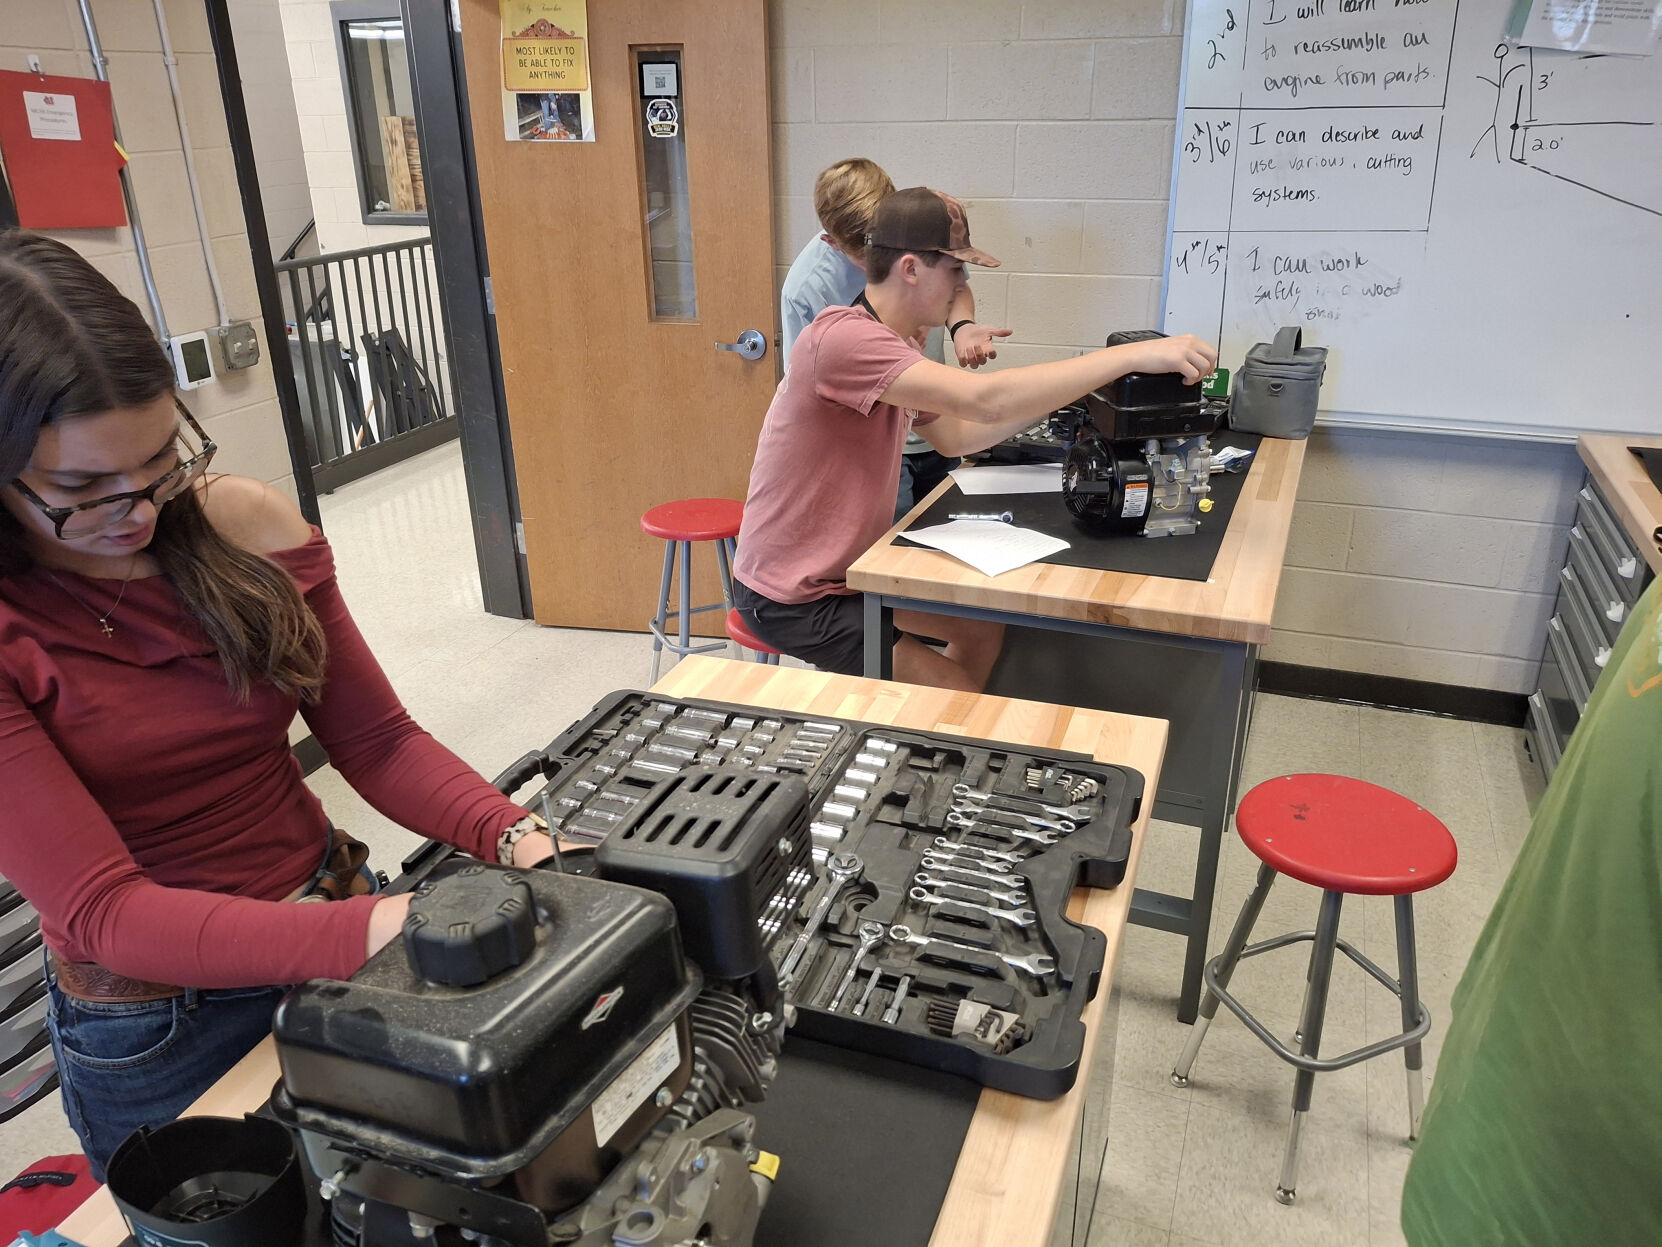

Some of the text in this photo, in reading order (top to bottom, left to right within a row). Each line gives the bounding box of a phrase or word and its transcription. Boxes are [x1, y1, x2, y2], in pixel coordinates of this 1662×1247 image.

[1263, 0, 1286, 25] I
[1297, 0, 1325, 19] will
[516, 47, 575, 56] MOST LIKELY TO
[1261, 37, 1277, 62] to
[519, 59, 574, 68] BE ABLE TO FIX
[529, 71, 566, 80] ANYTHING
[1264, 73, 1326, 98] engine
[1336, 65, 1376, 89] from
[1249, 121, 1424, 146] I can describe and
[1250, 157, 1277, 175] use
[1366, 152, 1412, 177] cutting
[1252, 186, 1320, 208] systems.
[1246, 246, 1261, 272] I
[1321, 251, 1369, 272] work
[1362, 276, 1402, 298] wood
